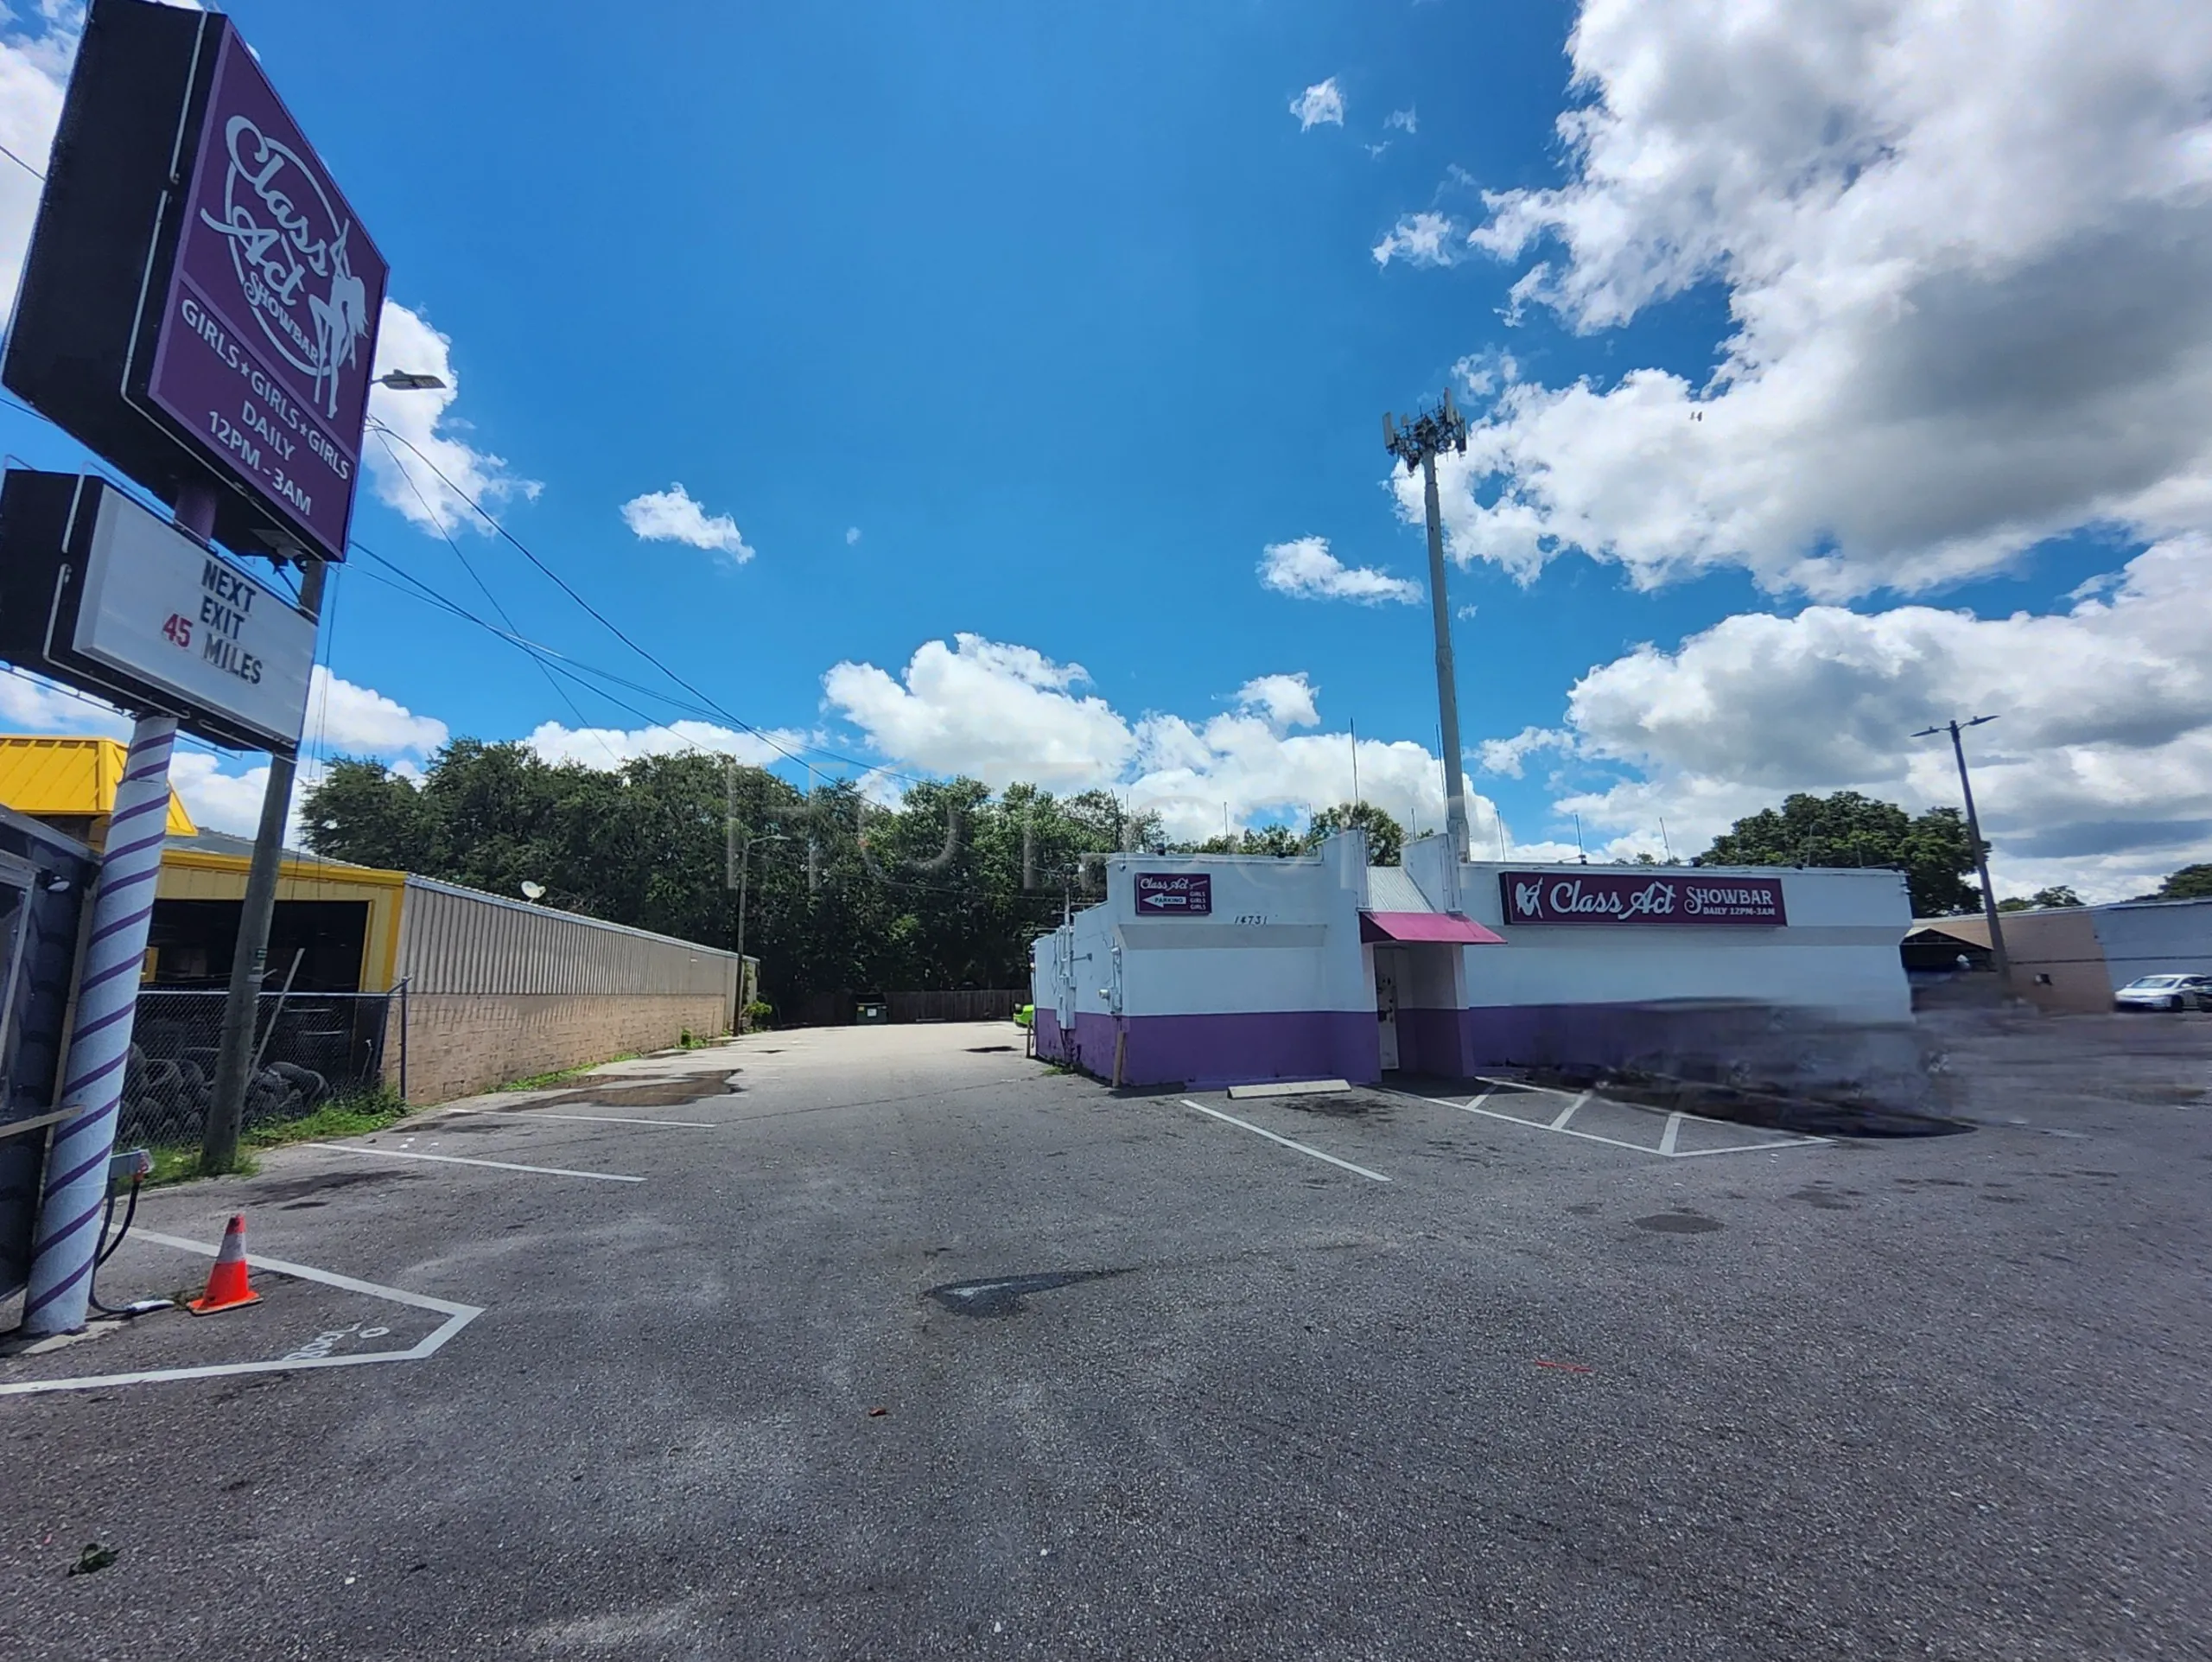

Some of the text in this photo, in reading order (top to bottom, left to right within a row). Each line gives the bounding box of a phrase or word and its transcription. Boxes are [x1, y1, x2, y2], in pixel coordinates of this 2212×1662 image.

[226, 115, 328, 277] Class
[200, 206, 305, 305] Act
[244, 271, 321, 366] SHOWBAR
[181, 299, 350, 480] GIRLS GIRLS GIRLS
[209, 411, 261, 471] 12PM
[271, 468, 312, 516] 3AM
[242, 400, 296, 462] DAILY
[200, 595, 245, 640] EXIT
[201, 559, 257, 613] NEXT
[162, 613, 263, 685] 45 MILES
[1140, 877, 1189, 891] Class Act
[1550, 879, 1774, 920] Class Act SHOWBAR
[1703, 907, 1776, 916] DAILY 12PM-3AM
